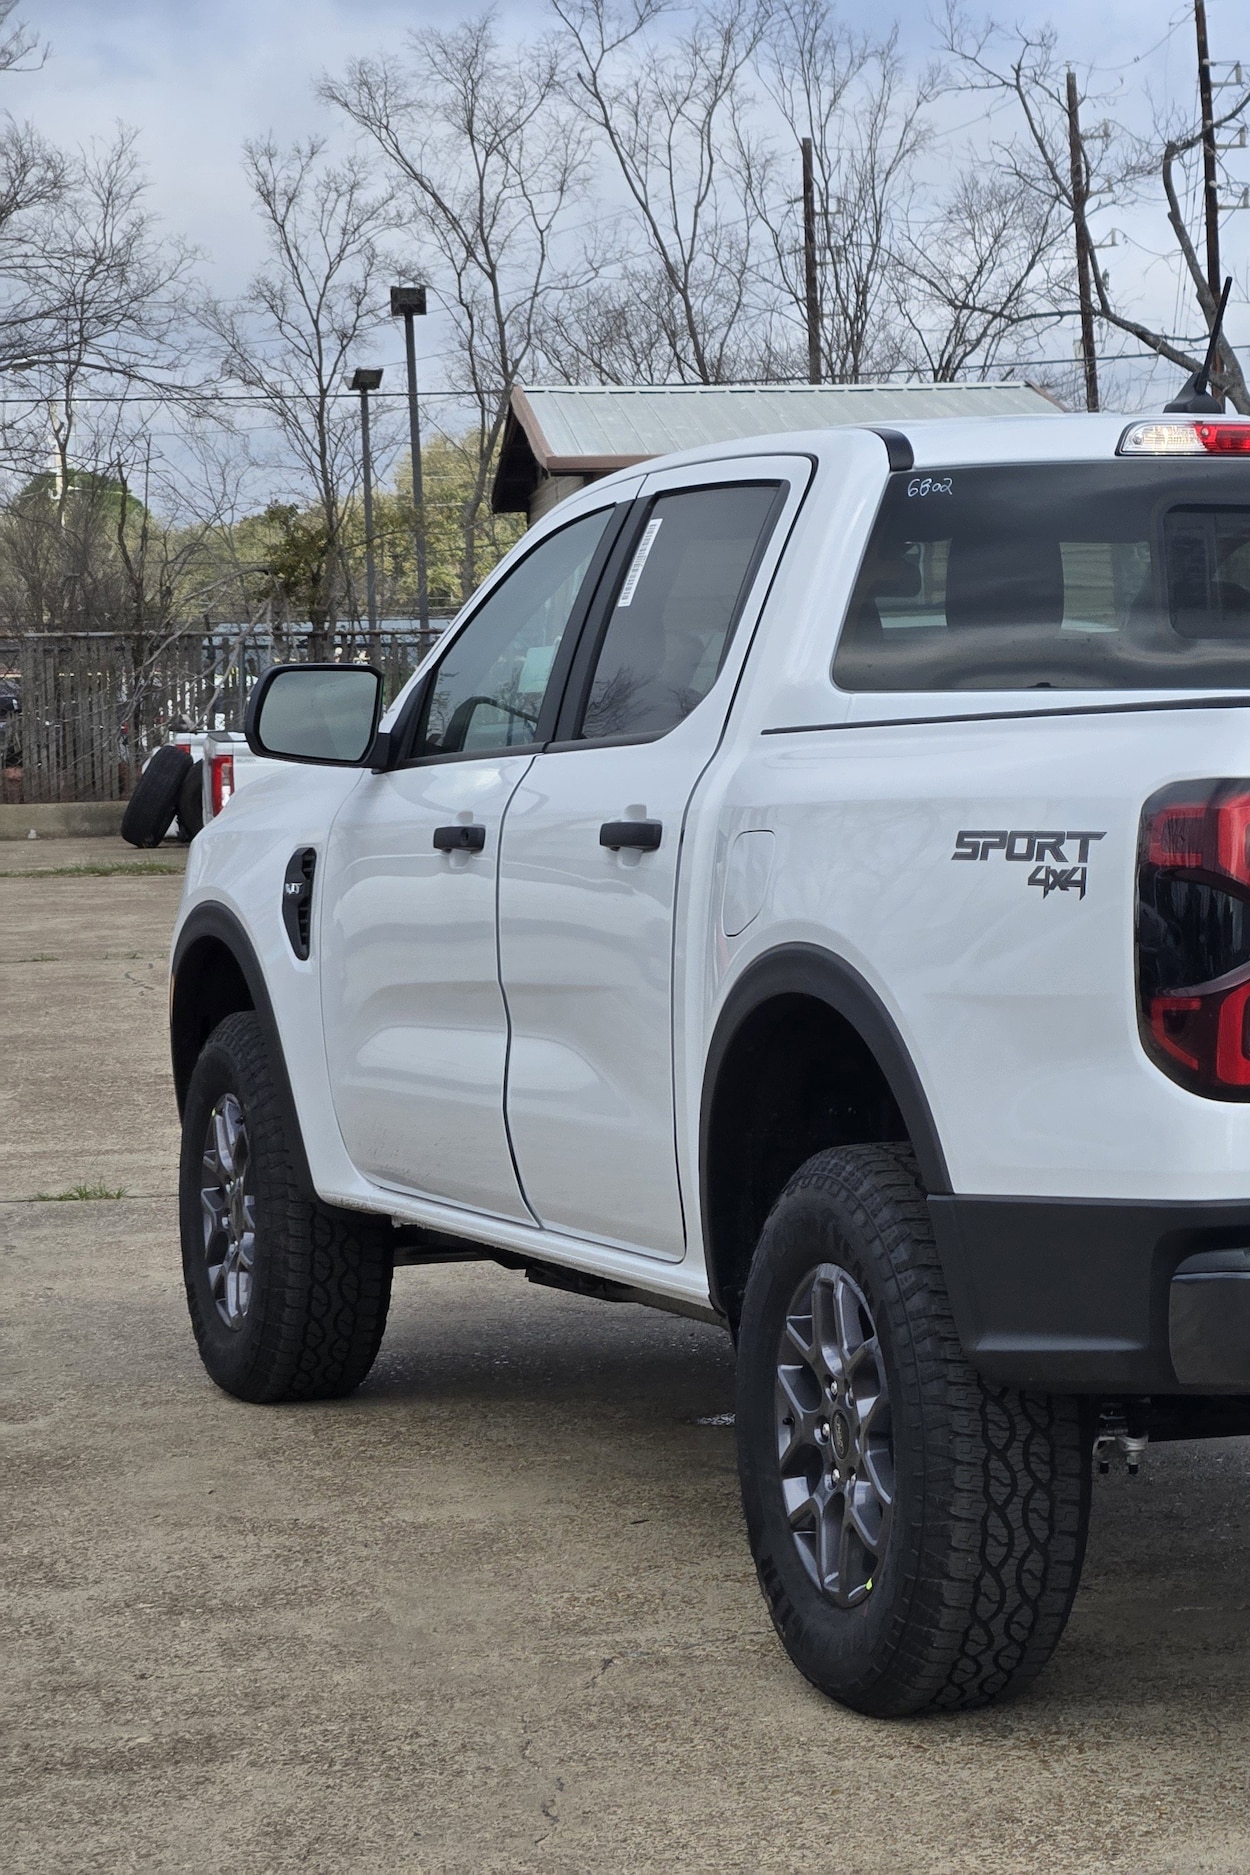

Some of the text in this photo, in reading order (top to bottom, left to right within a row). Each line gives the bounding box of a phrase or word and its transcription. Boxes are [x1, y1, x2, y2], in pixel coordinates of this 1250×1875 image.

[907, 477, 953, 497] 6802
[950, 830, 1107, 864] SPORT
[1027, 865, 1088, 901] 4x4
